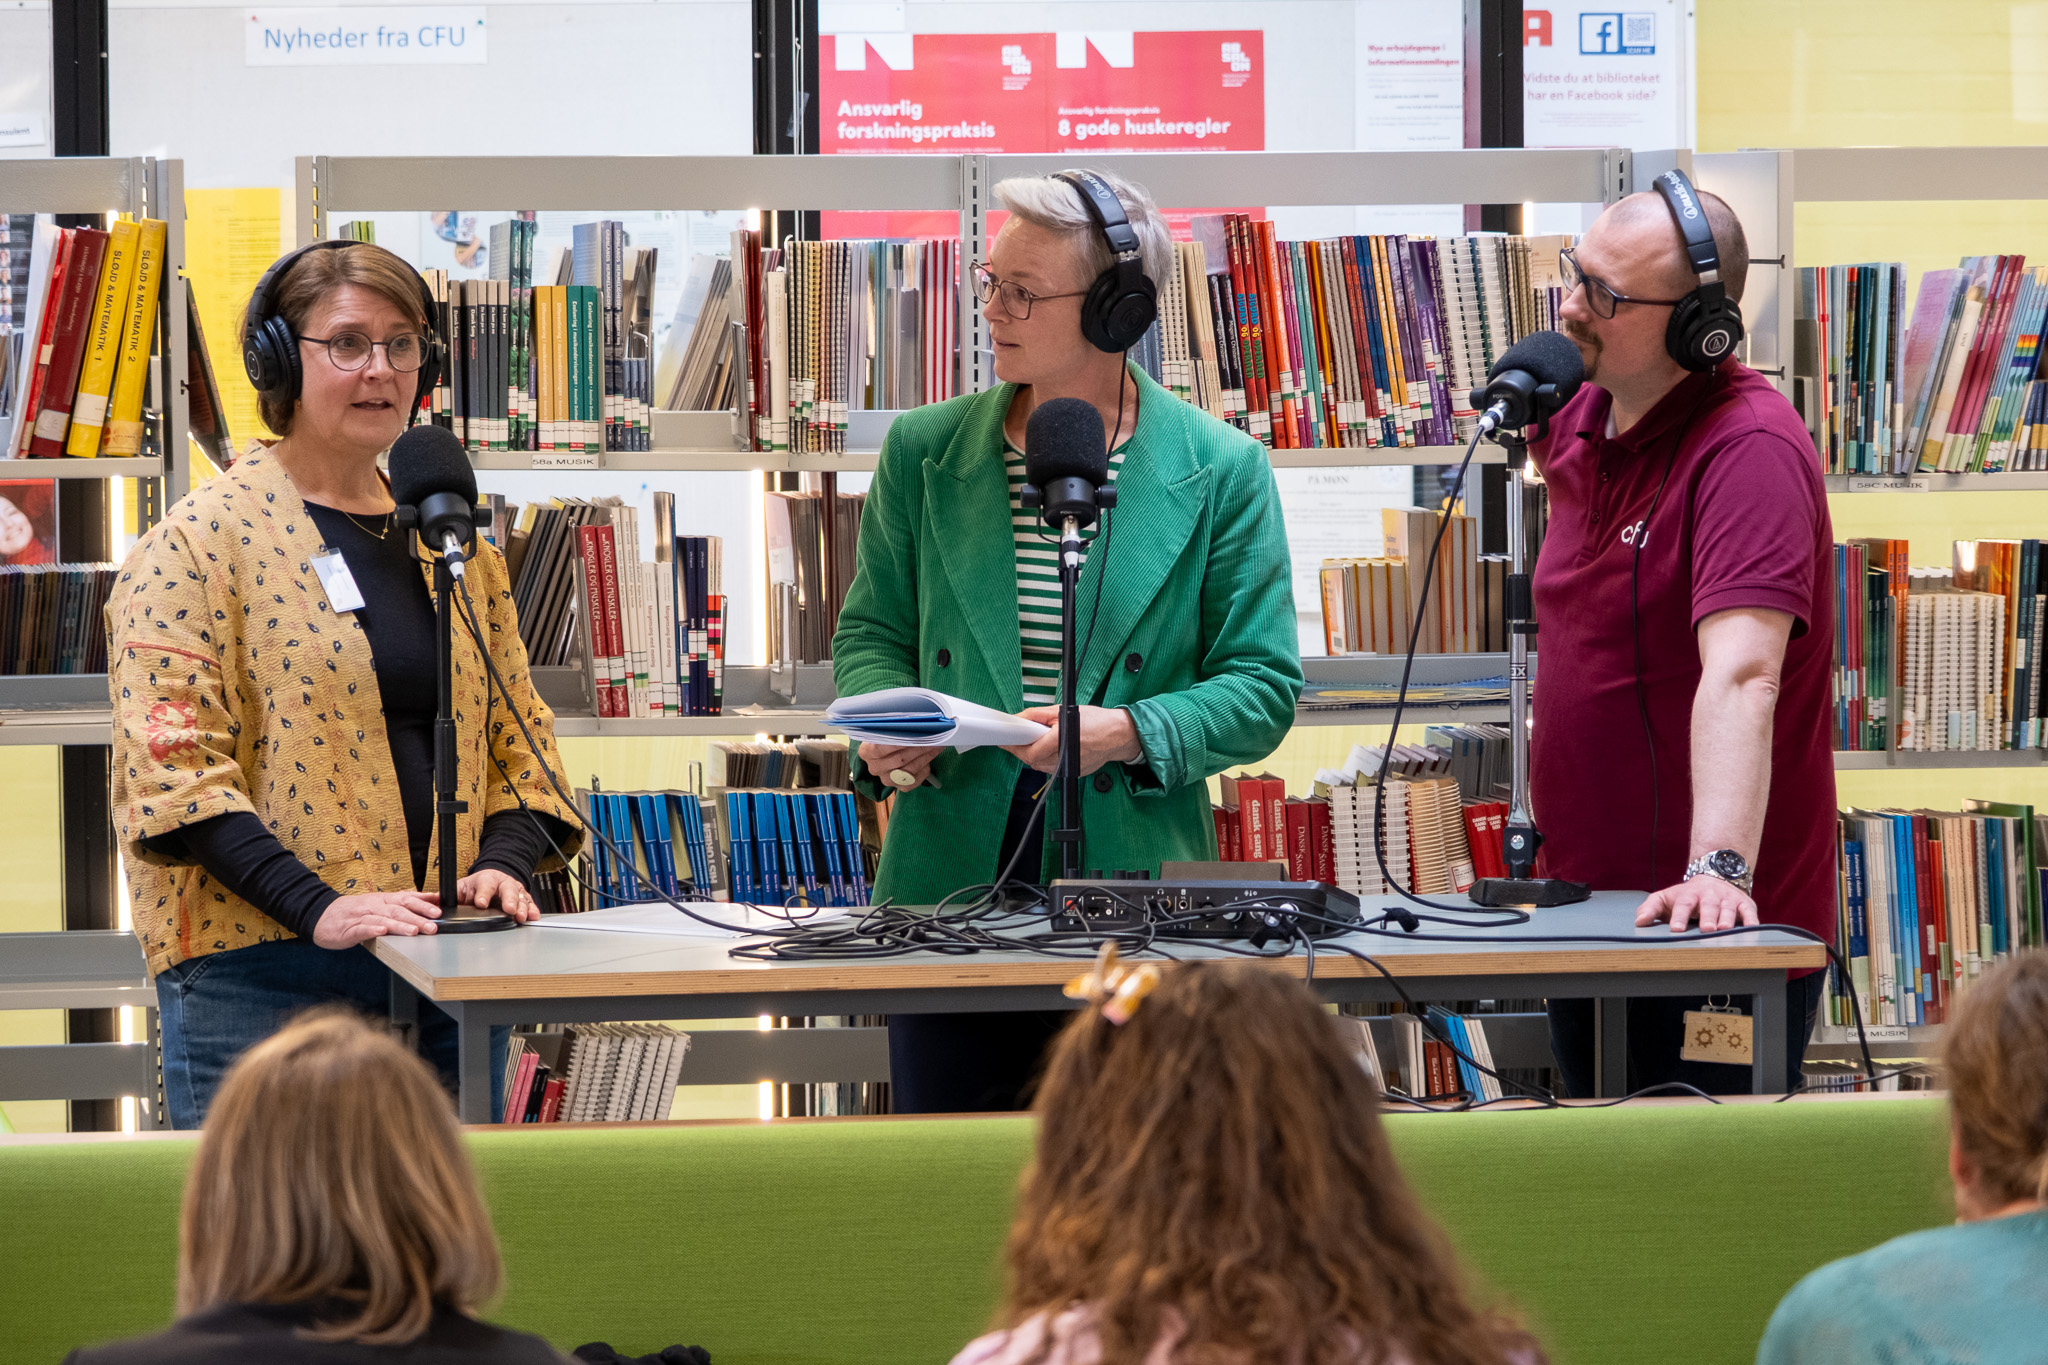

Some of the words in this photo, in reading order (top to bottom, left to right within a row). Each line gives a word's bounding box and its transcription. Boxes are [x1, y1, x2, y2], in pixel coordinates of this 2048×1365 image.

[265, 27, 369, 53] Nyheder
[377, 26, 409, 47] fra
[418, 26, 465, 47] CFU
[1523, 73, 1560, 83] Vidste
[1563, 73, 1578, 83] du
[1581, 75, 1593, 83] at
[1597, 72, 1660, 83] biblioteket
[1527, 90, 1546, 100] har
[1568, 90, 1623, 100] Facebook
[1627, 90, 1656, 100] side?
[837, 100, 922, 120] Ansvarlig
[1058, 107, 1094, 116] Ansvarlig
[1095, 106, 1160, 116] forskningspraksis
[837, 121, 996, 142] forskningspraksis
[1058, 119, 1071, 136] 8
[1075, 119, 1121, 140] gode
[1125, 117, 1231, 138] huskeregler
[109, 250, 122, 283] SLØJD
[138, 250, 151, 282] SLØJD
[96, 294, 114, 351] MATEMATIK
[129, 294, 145, 351] MATEMATIK
[1237, 293, 1247, 325] SIGURD
[1248, 293, 1258, 325] SIGURD
[1240, 327, 1249, 337] OG
[1252, 327, 1260, 337] OG
[1243, 340, 1253, 379] OPERAEN
[1254, 340, 1264, 379] OPERAEN
[585, 540, 597, 574] KNOGLER
[602, 540, 613, 574] KNOGLER
[589, 575, 598, 586] OG
[606, 574, 614, 586] OG
[590, 587, 600, 620] MUSKLER
[606, 587, 617, 620] MUSKLER
[2020, 597, 2028, 624] Børnekor
[647, 605, 655, 636] Morgensang
[664, 605, 672, 636] Morgensang
[665, 648, 673, 668] mening
[1251, 799, 1262, 832] dansk
[1273, 799, 1284, 831] dansk
[1253, 834, 1262, 858] sang
[1275, 833, 1284, 858] sang
[1297, 826, 1305, 854] DANSK
[1321, 826, 1329, 853] DANSK
[703, 823, 718, 884] HISTORIEN
[1295, 854, 1303, 876] SANG
[1318, 853, 1326, 875] SANG
